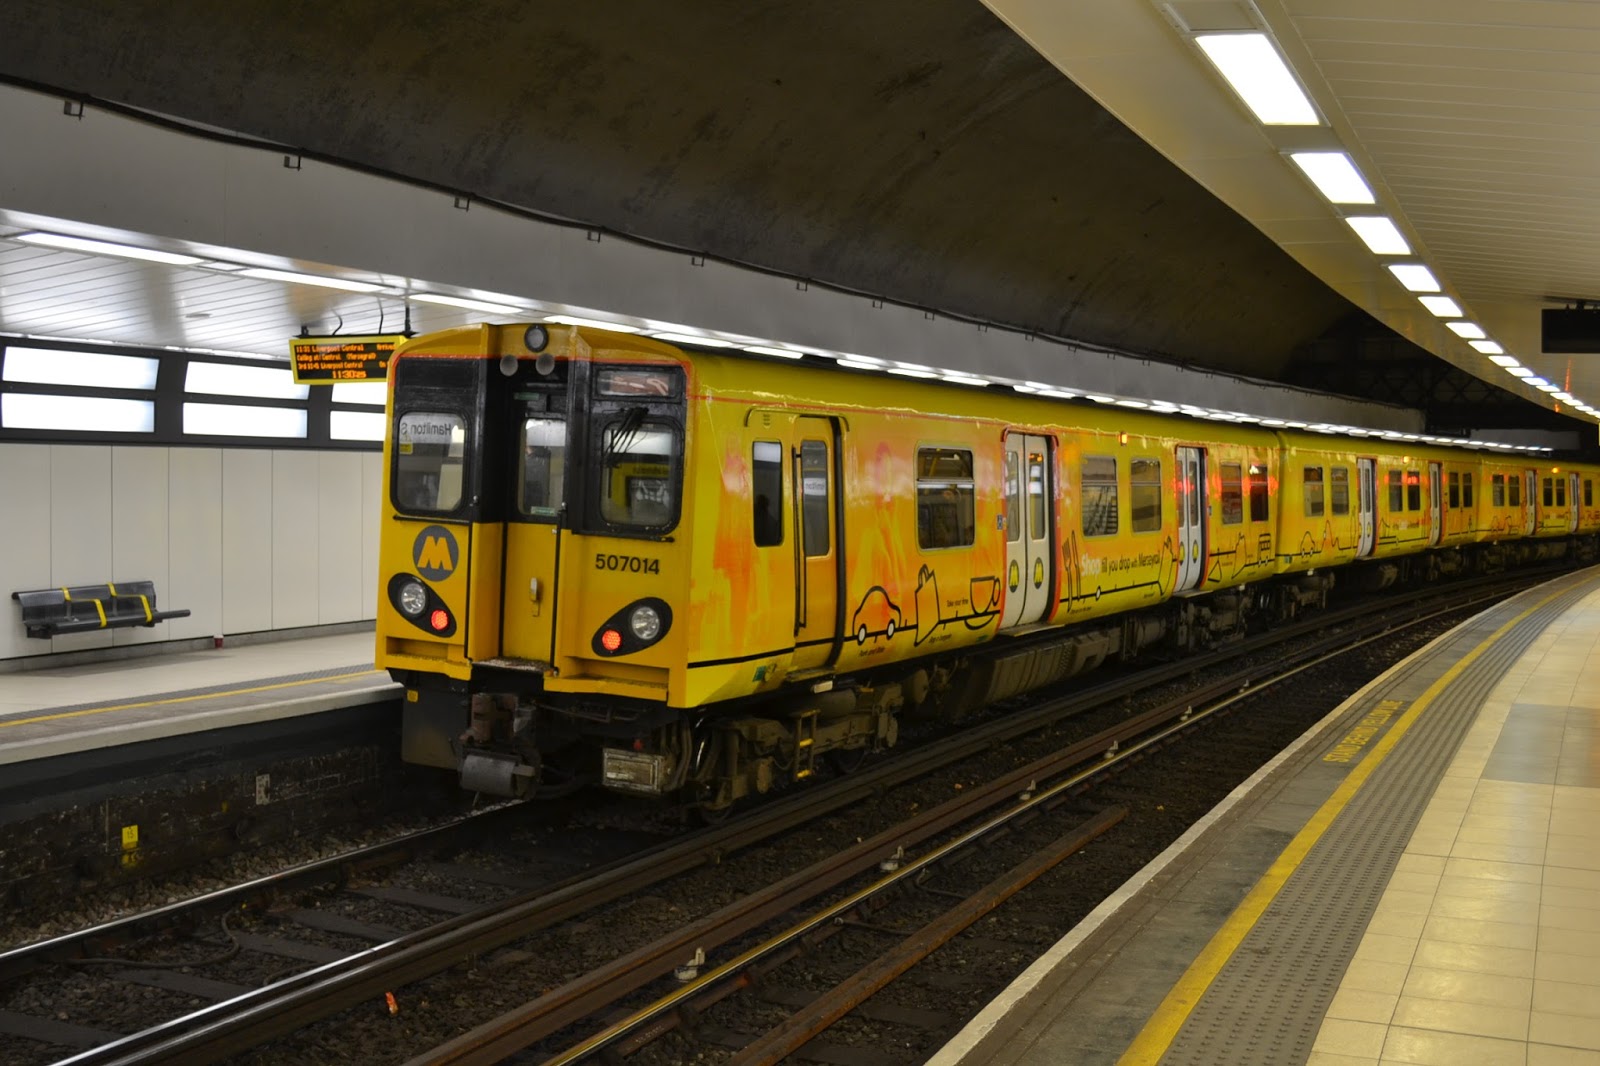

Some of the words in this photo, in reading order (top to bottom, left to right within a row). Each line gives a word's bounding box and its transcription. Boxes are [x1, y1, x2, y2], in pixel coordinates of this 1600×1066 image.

[312, 344, 340, 353] Liverpool
[342, 343, 364, 352] Central
[321, 362, 343, 370] Liverpool
[344, 361, 363, 369] Central
[417, 535, 454, 571] M
[595, 553, 660, 575] 507014
[1081, 552, 1100, 576] Shop
[1109, 560, 1119, 576] you
[1119, 555, 1131, 574] drop
[1138, 550, 1161, 569] Merseyrail
[126, 829, 134, 840] 15
